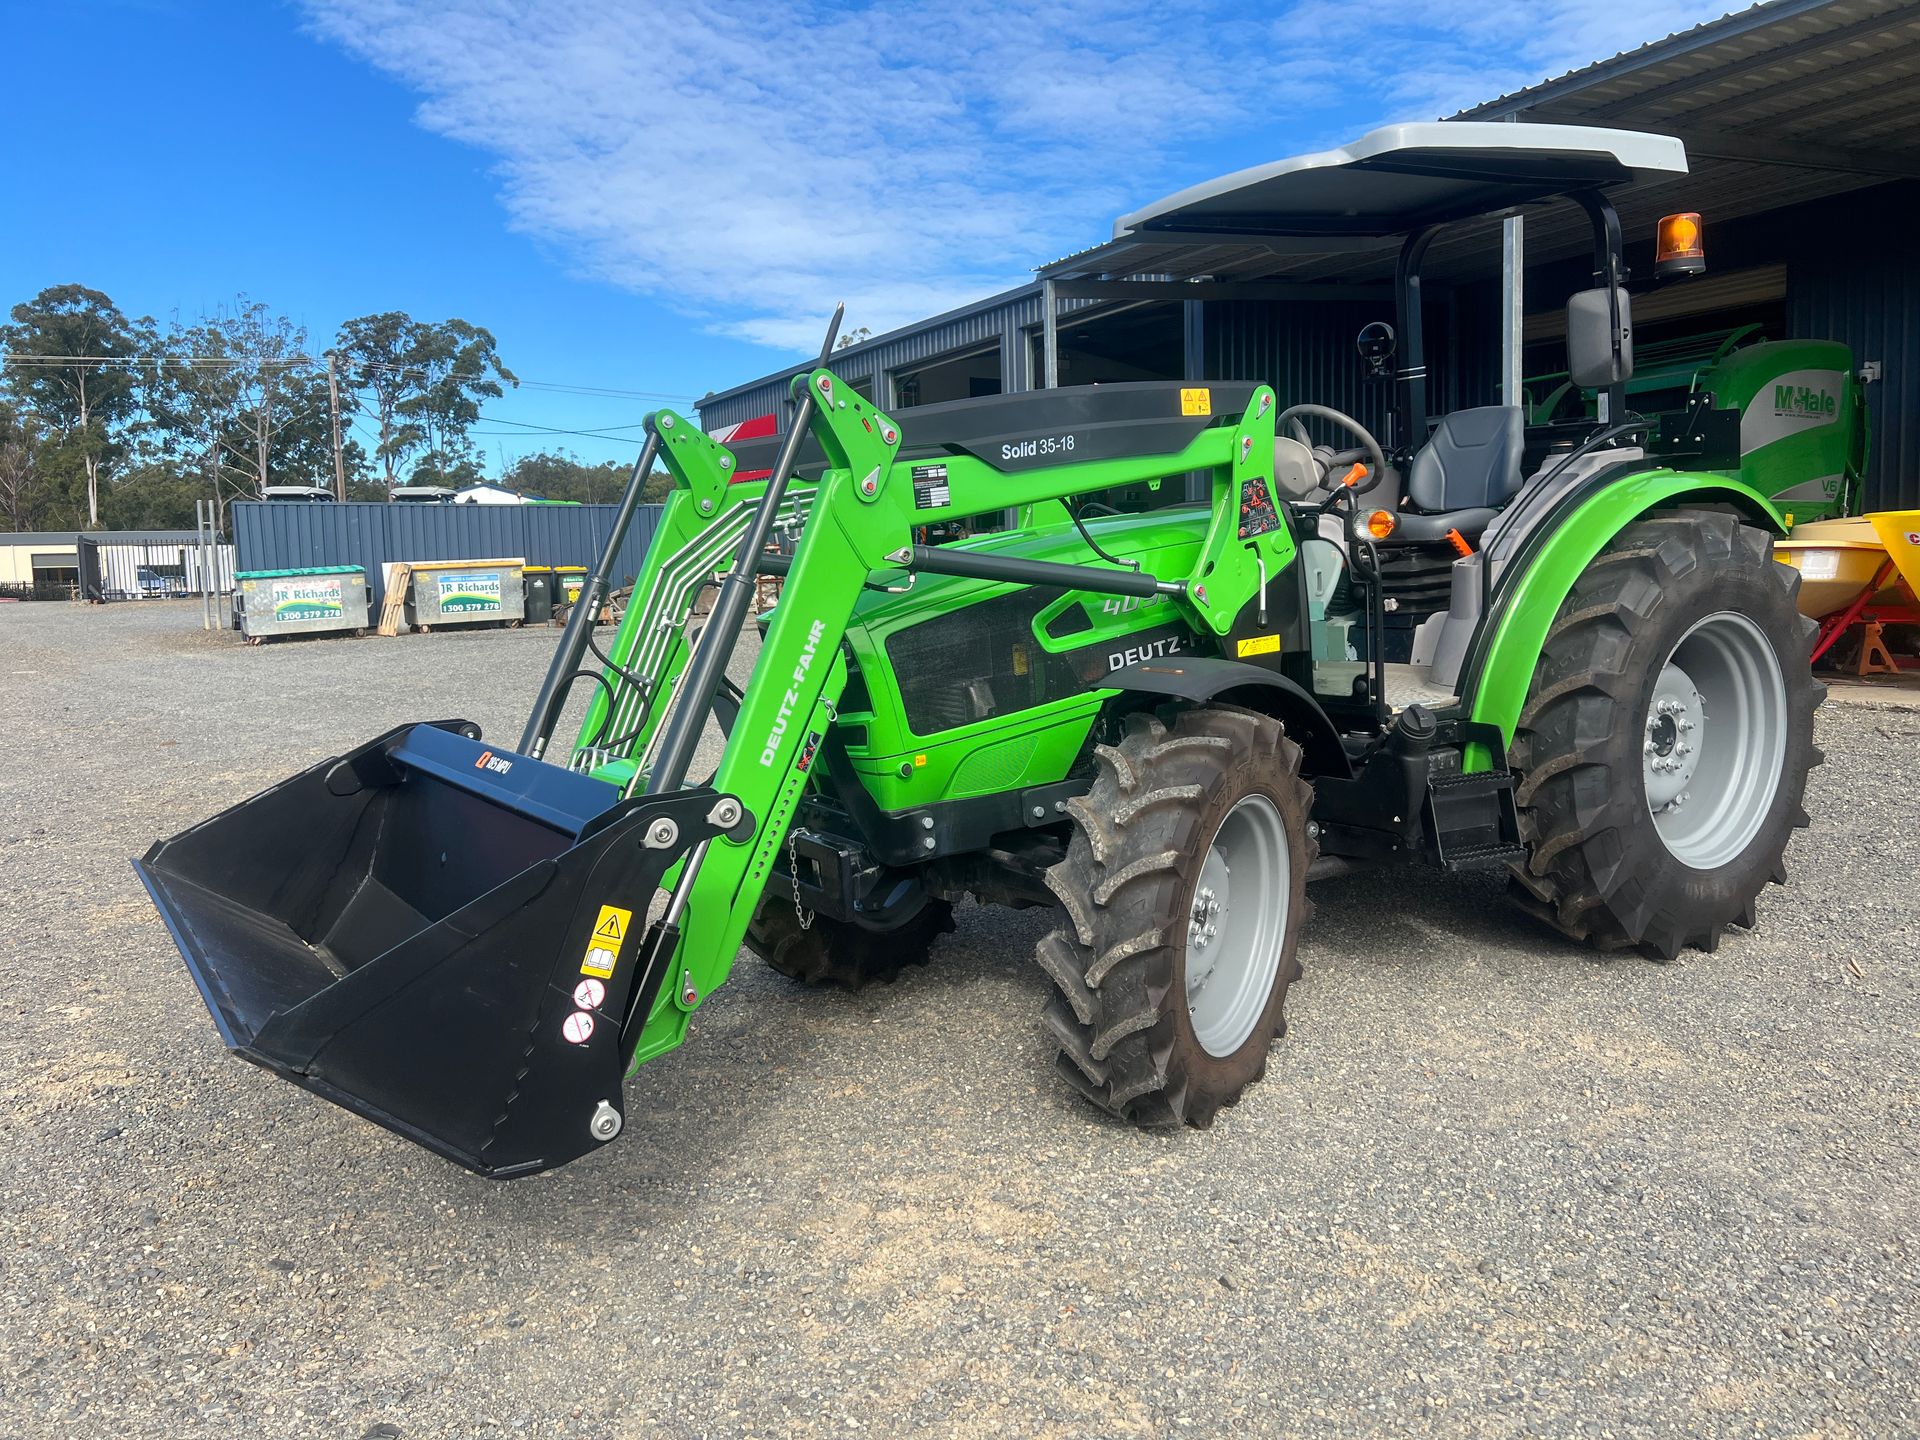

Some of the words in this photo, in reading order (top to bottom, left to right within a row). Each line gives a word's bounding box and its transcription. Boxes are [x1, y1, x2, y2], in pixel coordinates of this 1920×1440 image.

[1002, 441, 1036, 459] Solid
[1040, 435, 1075, 454] 35-18
[1821, 479, 1837, 492] V6
[441, 583, 453, 594] JR
[458, 582, 499, 592] Richards
[275, 590, 289, 602] JR
[443, 604, 464, 612] 1300
[466, 603, 482, 611] 579
[484, 602, 500, 610] 278
[1103, 592, 1171, 616] 40
[278, 611, 301, 621] 1300
[304, 610, 320, 619] 579
[324, 609, 341, 618] 278
[759, 619, 826, 768] DEUTZ-FAHR
